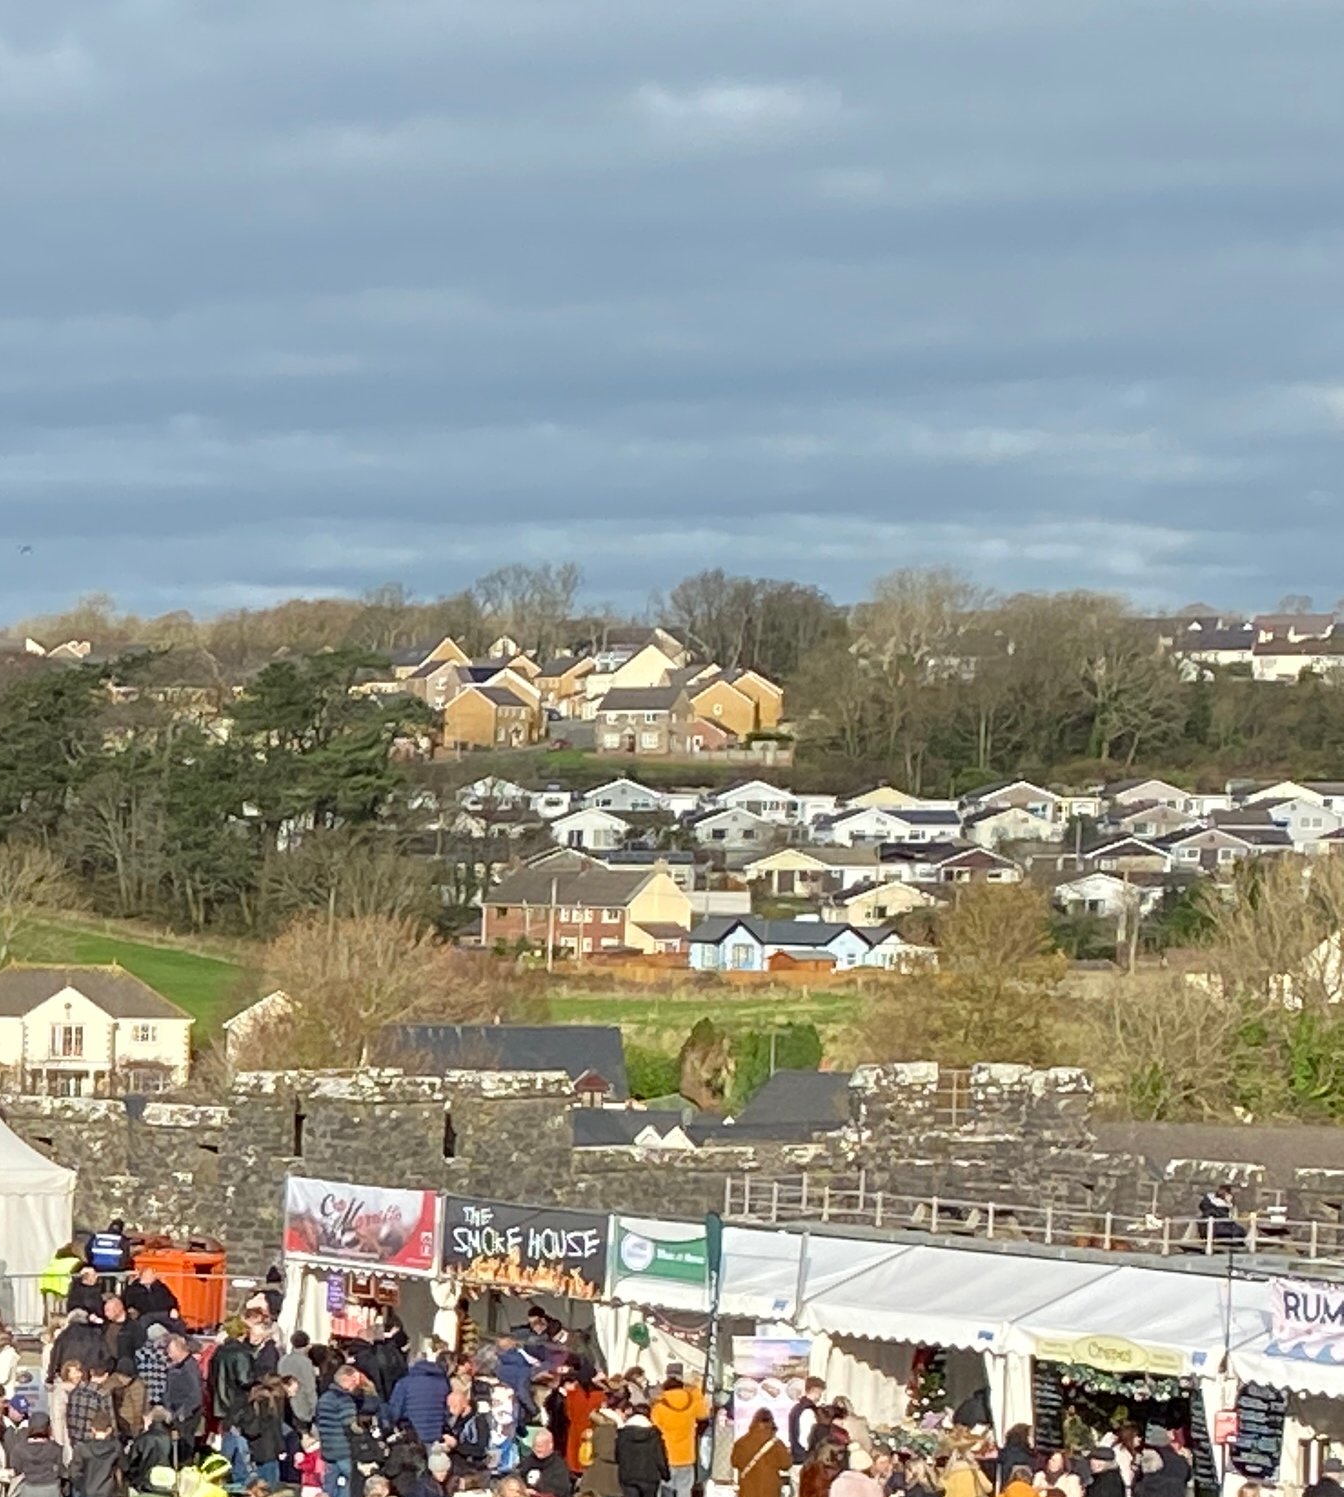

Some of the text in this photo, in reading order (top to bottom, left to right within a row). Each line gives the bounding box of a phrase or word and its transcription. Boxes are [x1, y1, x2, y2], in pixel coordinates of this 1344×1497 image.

[463, 1206, 494, 1227] THE
[453, 1227, 523, 1258] SMOKE
[528, 1228, 600, 1260] HOUSE
[1283, 1290, 1344, 1326] RUM
